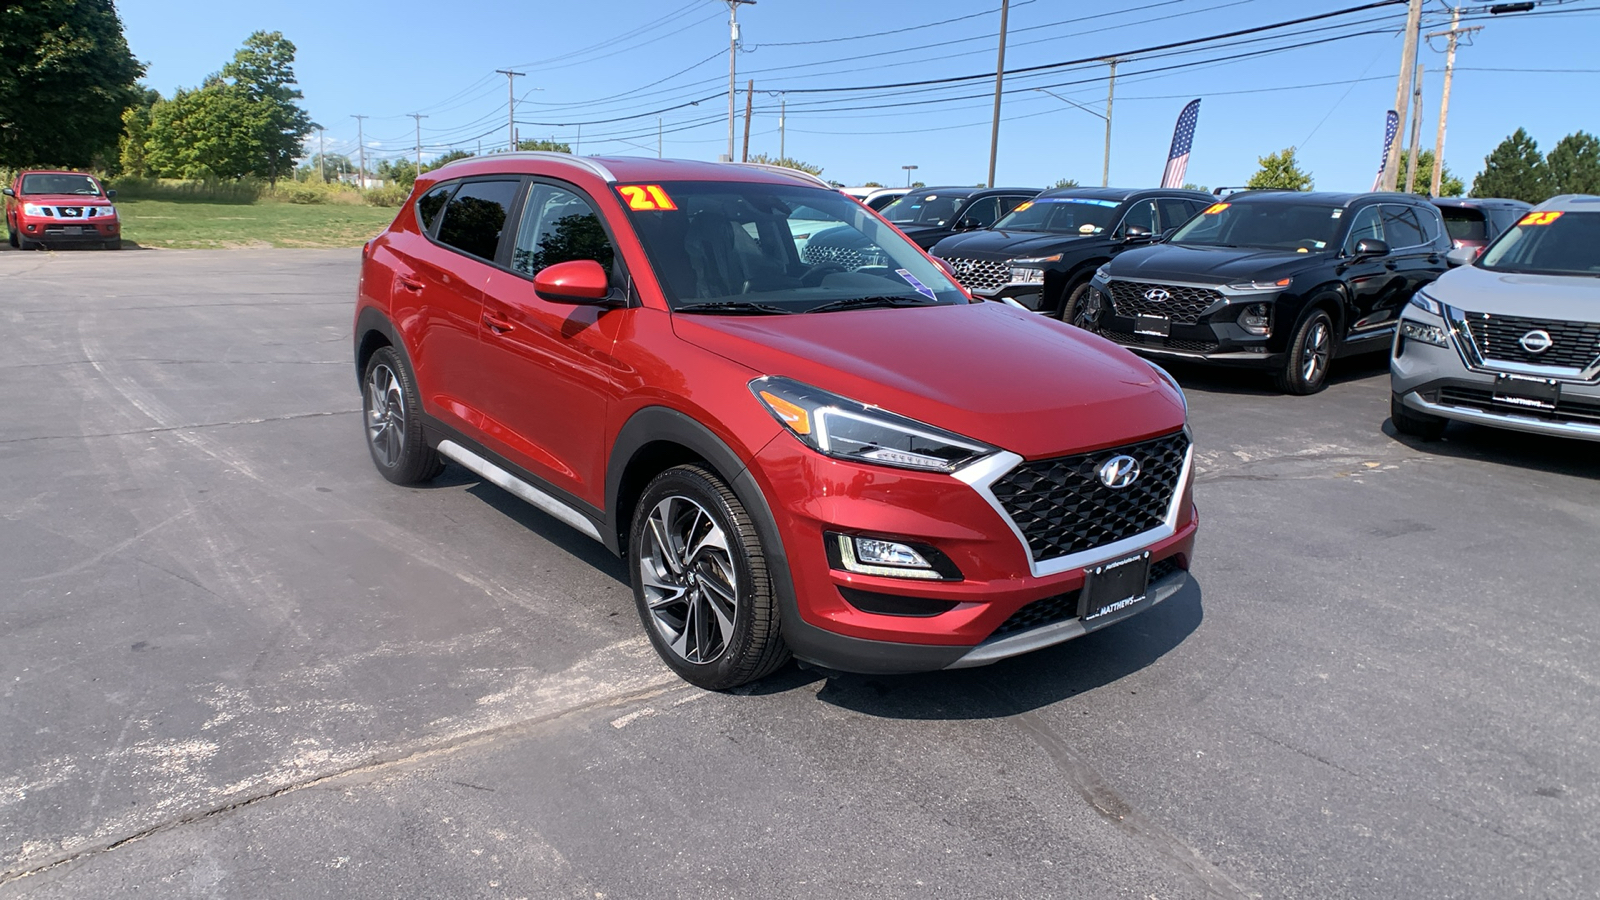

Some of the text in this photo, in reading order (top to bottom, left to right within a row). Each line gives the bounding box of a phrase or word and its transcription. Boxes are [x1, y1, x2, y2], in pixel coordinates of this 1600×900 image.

[620, 186, 673, 209] 21
[1519, 212, 1562, 225] 23
[1100, 595, 1135, 616] MATTHEWS
